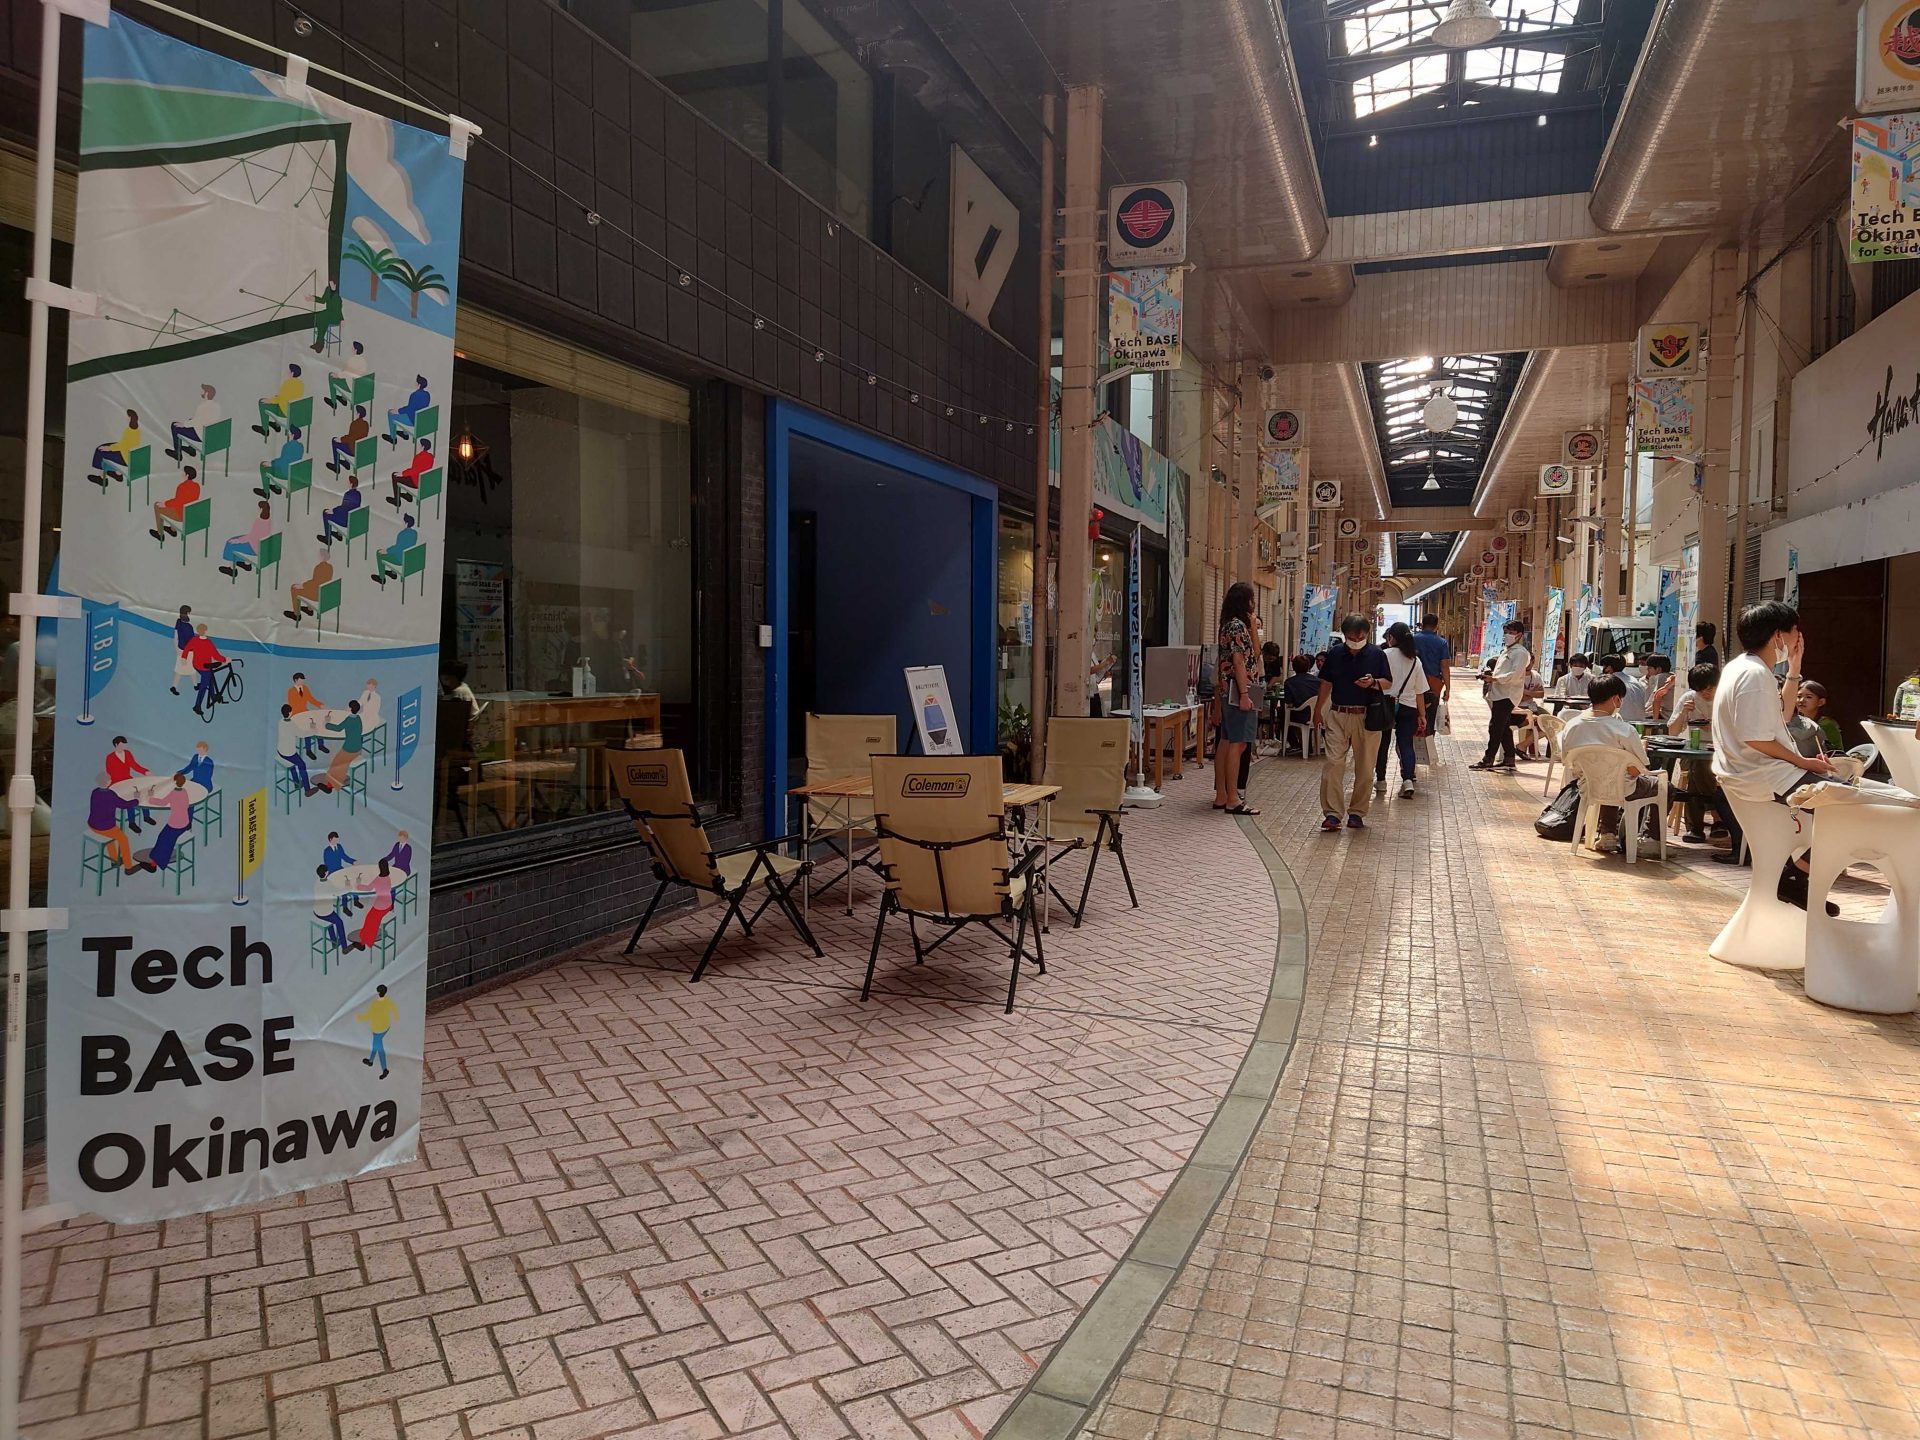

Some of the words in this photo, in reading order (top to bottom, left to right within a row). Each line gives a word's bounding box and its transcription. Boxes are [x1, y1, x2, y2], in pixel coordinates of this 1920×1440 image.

[1858, 209, 1904, 226] Tech
[1858, 246, 1879, 257] for
[1114, 336, 1142, 347] Tech
[1146, 334, 1178, 346] BASE
[1114, 348, 1166, 360] Okinawa
[1638, 427, 1660, 436] Tech
[1664, 425, 1690, 434] BASE
[1638, 436, 1680, 444] Okinawa
[1303, 588, 1314, 612] Tech
[1300, 616, 1309, 644] BASE
[630, 768, 659, 780] Coleman
[909, 777, 954, 791] Coleman
[248, 798, 257, 815] Tech
[248, 815, 257, 834] BASE
[248, 834, 257, 863] Okinawa
[81, 925, 274, 998] Tech
[80, 1015, 296, 1096] BASE
[77, 1098, 398, 1193] Okinawa
